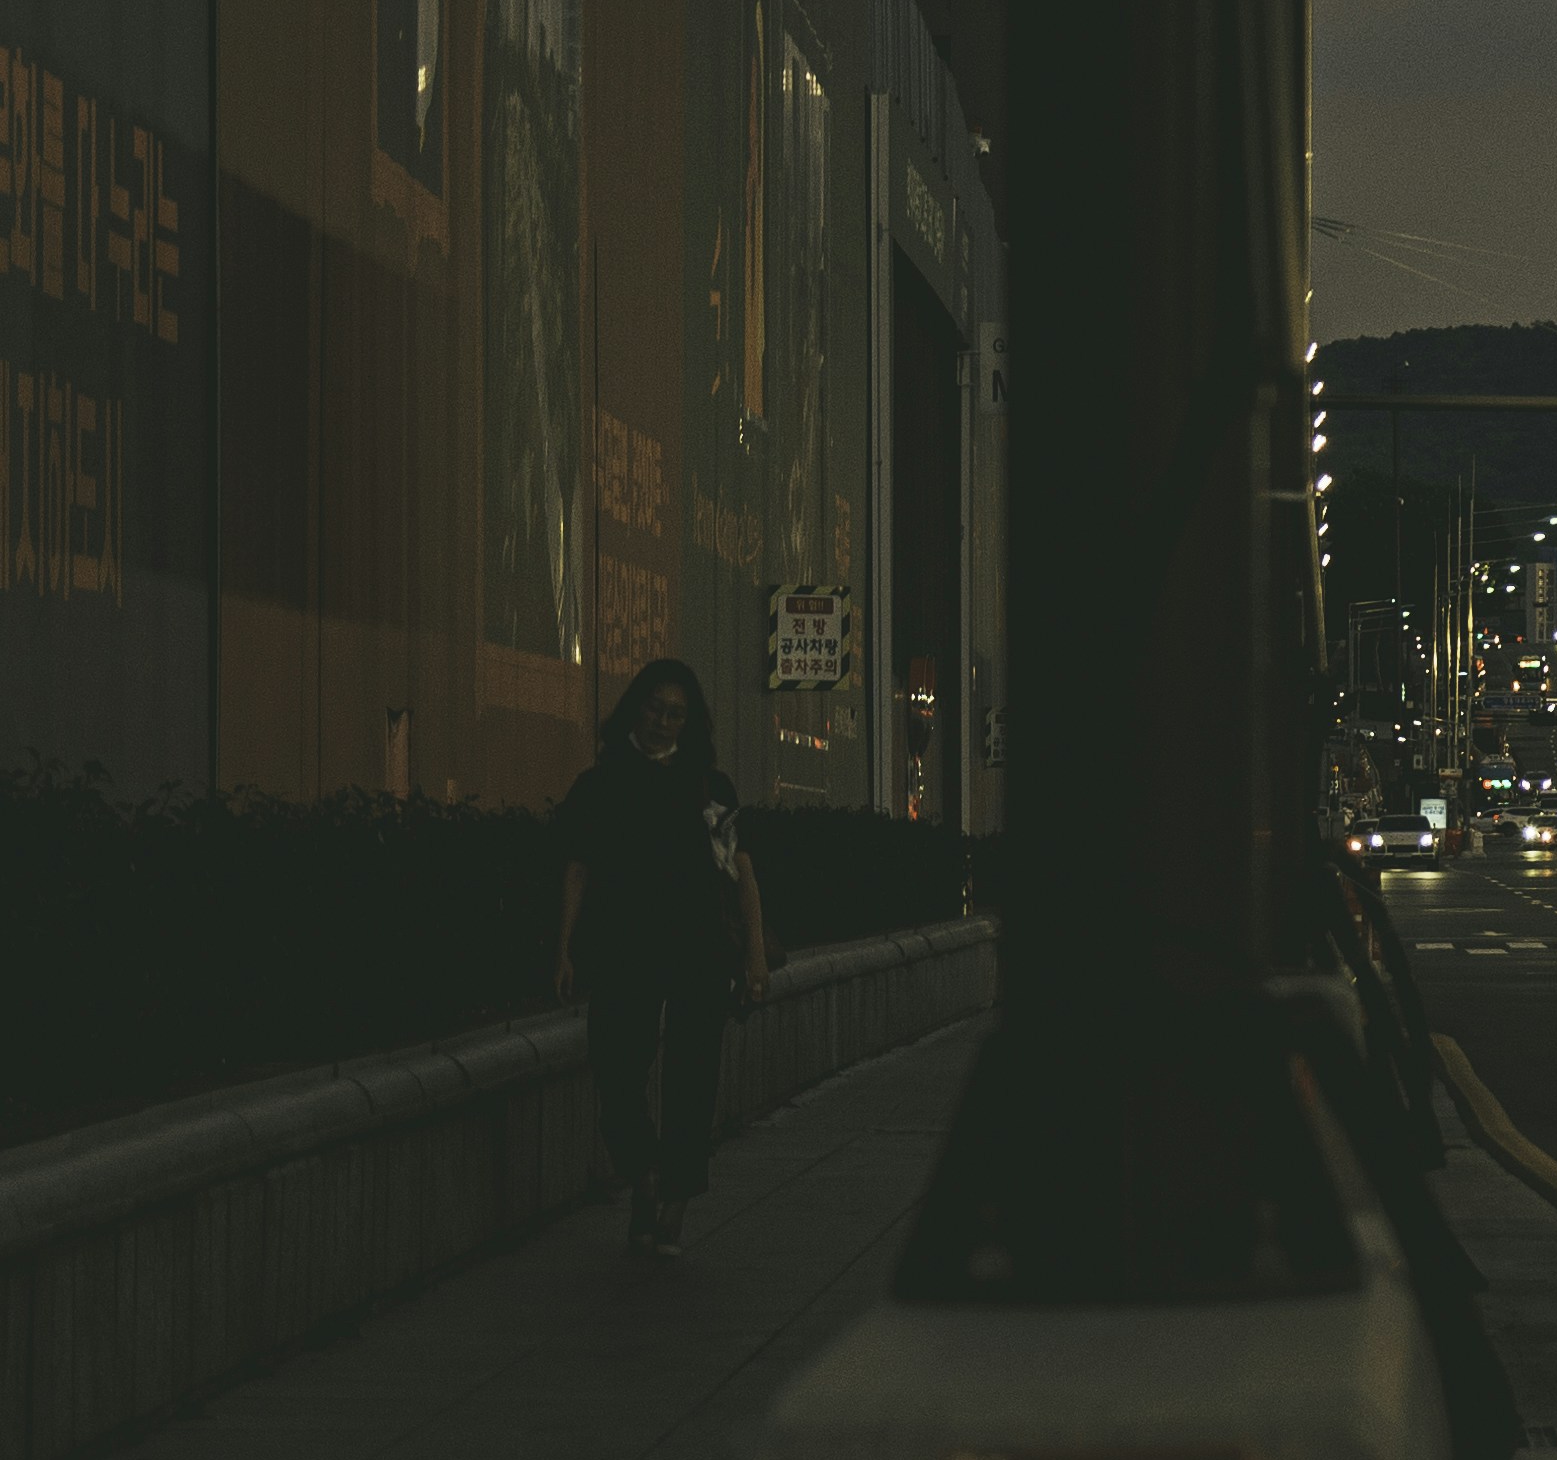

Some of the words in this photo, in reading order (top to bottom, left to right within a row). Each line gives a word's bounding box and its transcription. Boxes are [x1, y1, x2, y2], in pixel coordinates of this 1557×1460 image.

[793, 618, 806, 635] 전
[813, 618, 827, 635] 방
[781, 638, 838, 656] 공사차량
[781, 658, 838, 675] 출차주의
